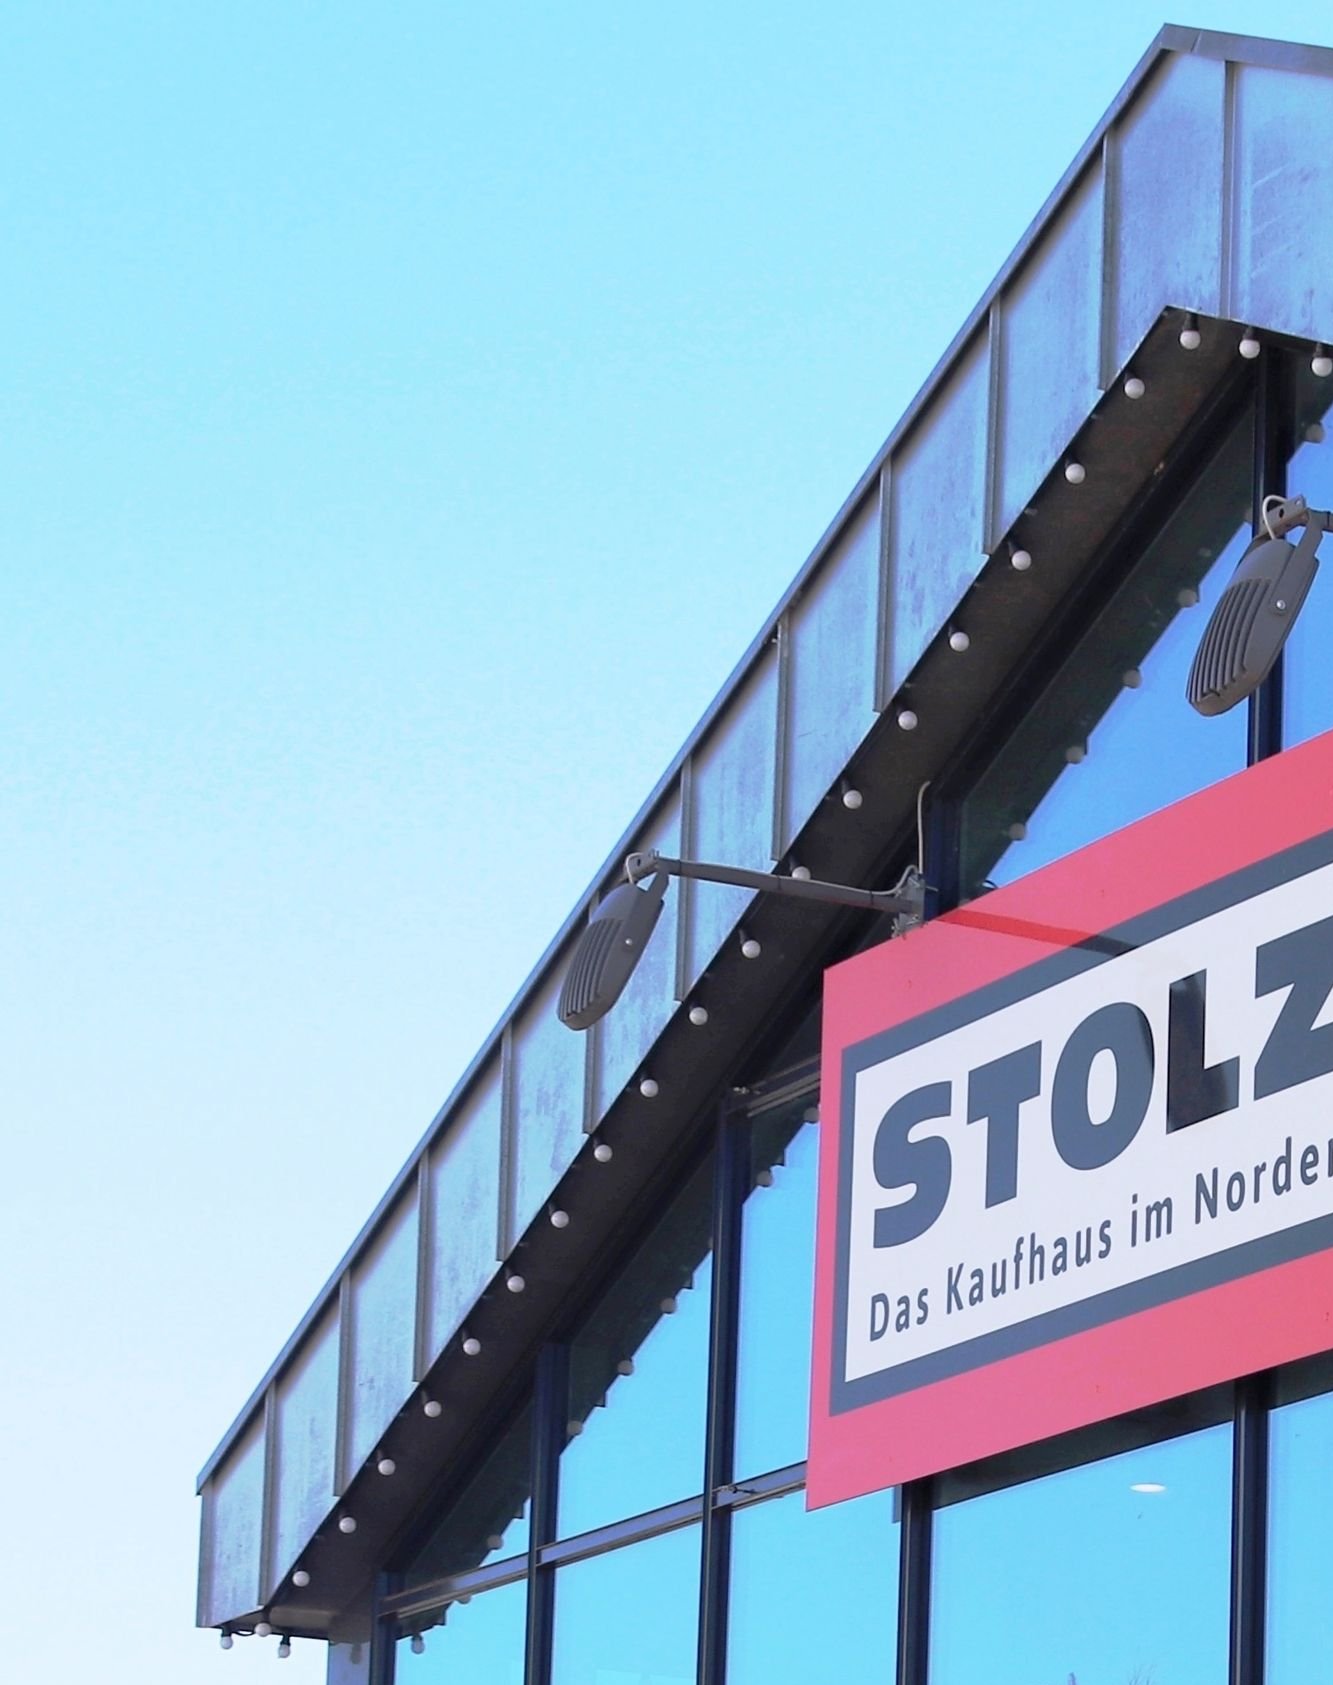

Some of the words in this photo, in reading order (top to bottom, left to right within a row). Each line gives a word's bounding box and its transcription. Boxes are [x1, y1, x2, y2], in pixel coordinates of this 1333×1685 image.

[868, 1285, 929, 1343] Das
[945, 1217, 1113, 1315] Kaufhaus
[1129, 1193, 1174, 1247] im
